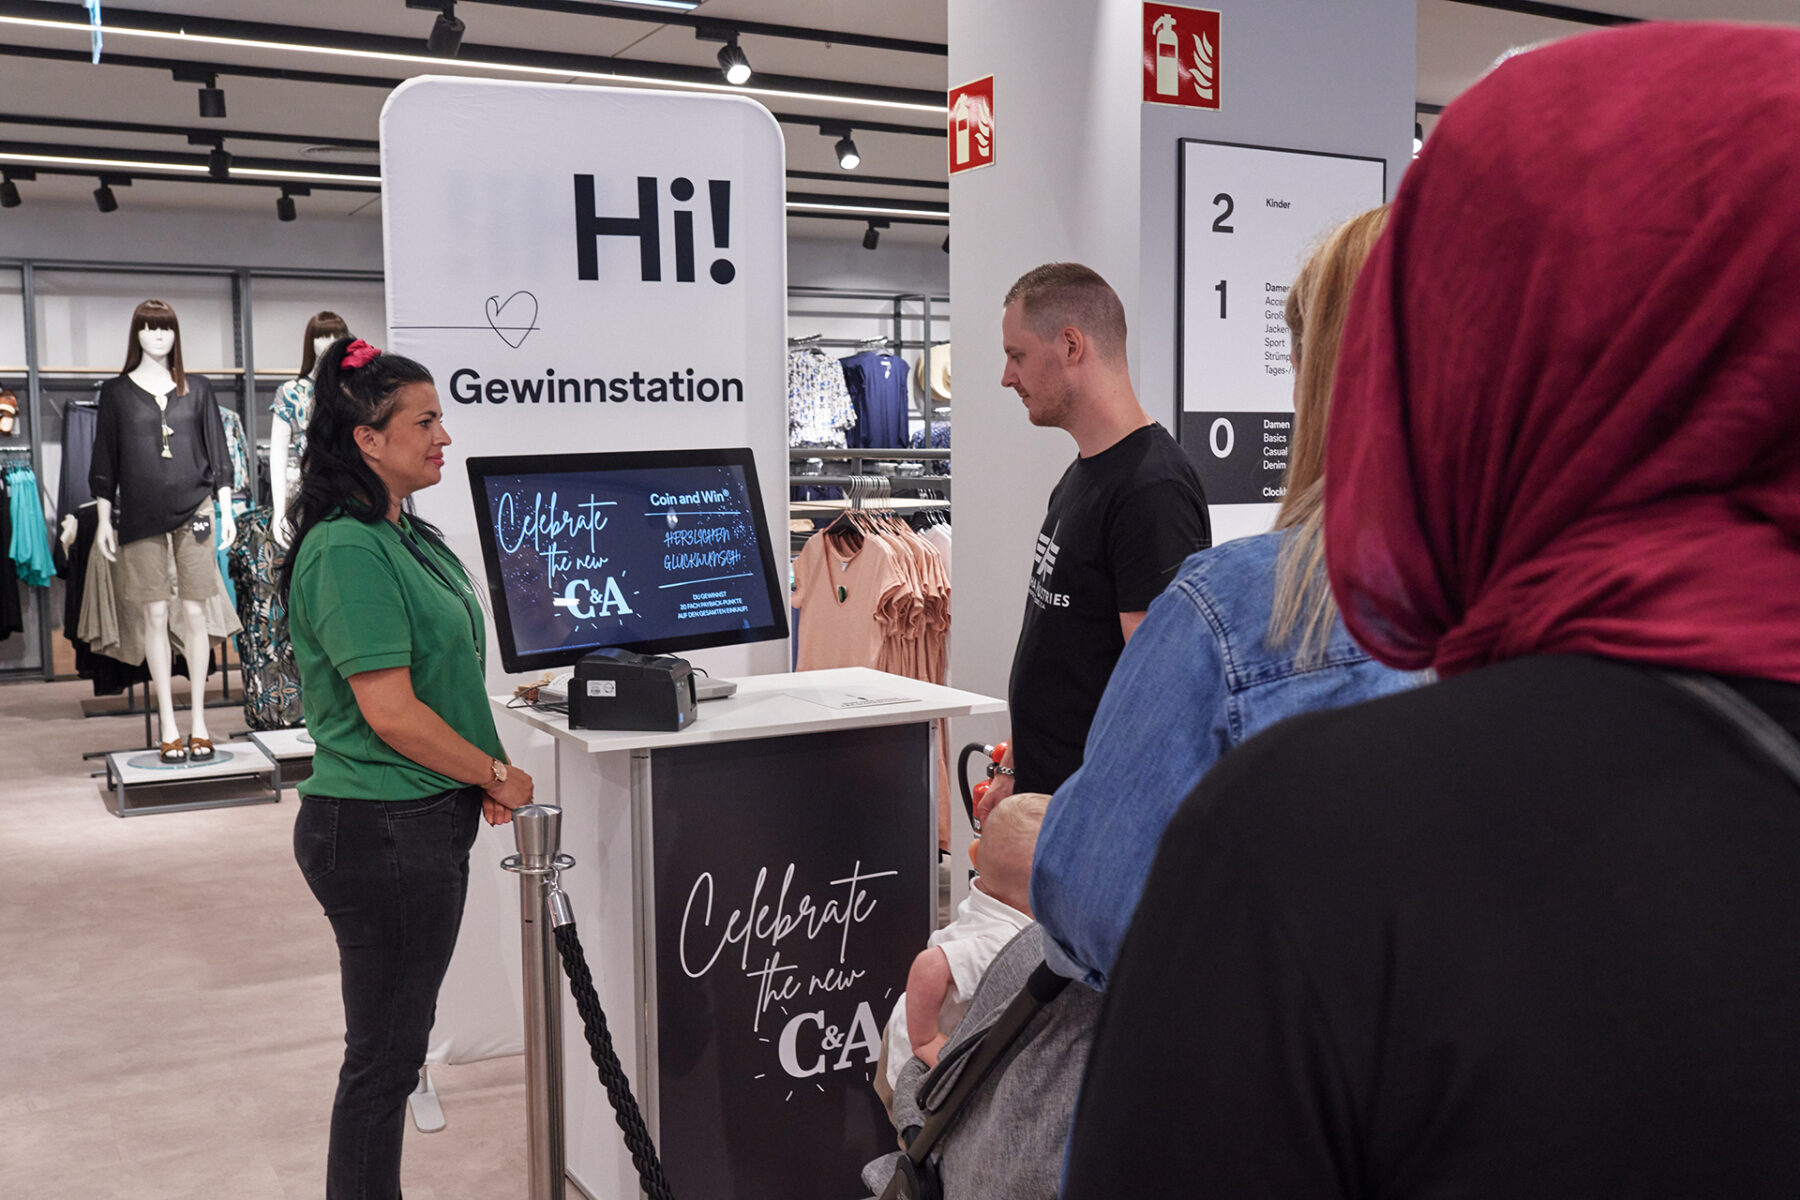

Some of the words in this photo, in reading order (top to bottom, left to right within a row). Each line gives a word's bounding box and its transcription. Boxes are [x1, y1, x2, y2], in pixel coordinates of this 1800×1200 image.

[1212, 193, 1235, 234] 2
[1265, 198, 1291, 210] Kinder
[573, 173, 736, 285] Hi!
[1214, 279, 1227, 319] 1
[1264, 323, 1290, 334] Jacken
[1264, 337, 1285, 348] Sport
[1264, 350, 1291, 363] Strümp
[449, 367, 744, 404] Gewinnstation
[1209, 417, 1235, 459] 0
[1263, 419, 1290, 429] Damen
[1263, 433, 1287, 443] Basics
[1263, 446, 1288, 456] Casual
[1263, 460, 1287, 470] Denim
[649, 492, 678, 506] Coin
[678, 490, 701, 505] and
[497, 491, 618, 554] Celebrate
[539, 541, 572, 589] the
[576, 554, 609, 570] new
[564, 575, 634, 620] C&A
[680, 860, 899, 978] Celebrate
[746, 951, 801, 1033] the
[808, 968, 866, 996] new
[778, 1001, 883, 1078] C&A
